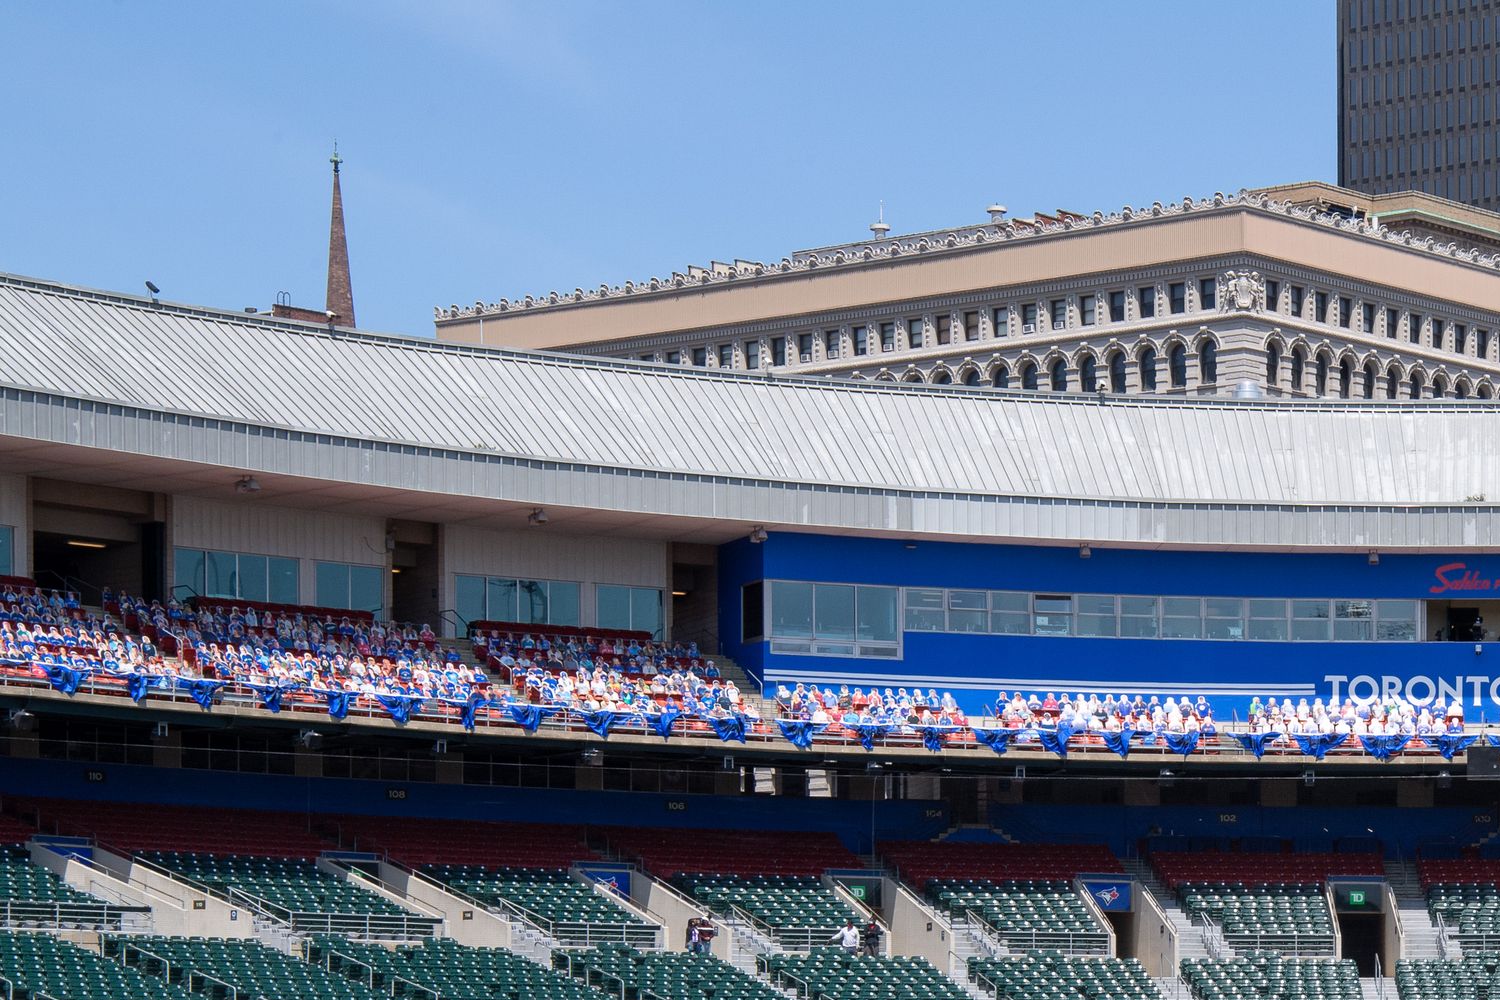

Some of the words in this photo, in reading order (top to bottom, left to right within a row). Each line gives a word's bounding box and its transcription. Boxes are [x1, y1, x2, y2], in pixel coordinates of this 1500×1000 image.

[89, 772, 103, 781] 110
[389, 790, 406, 798] 108
[668, 802, 685, 810] 106
[1220, 814, 1237, 822] 102
[1350, 893, 1364, 902] TD
